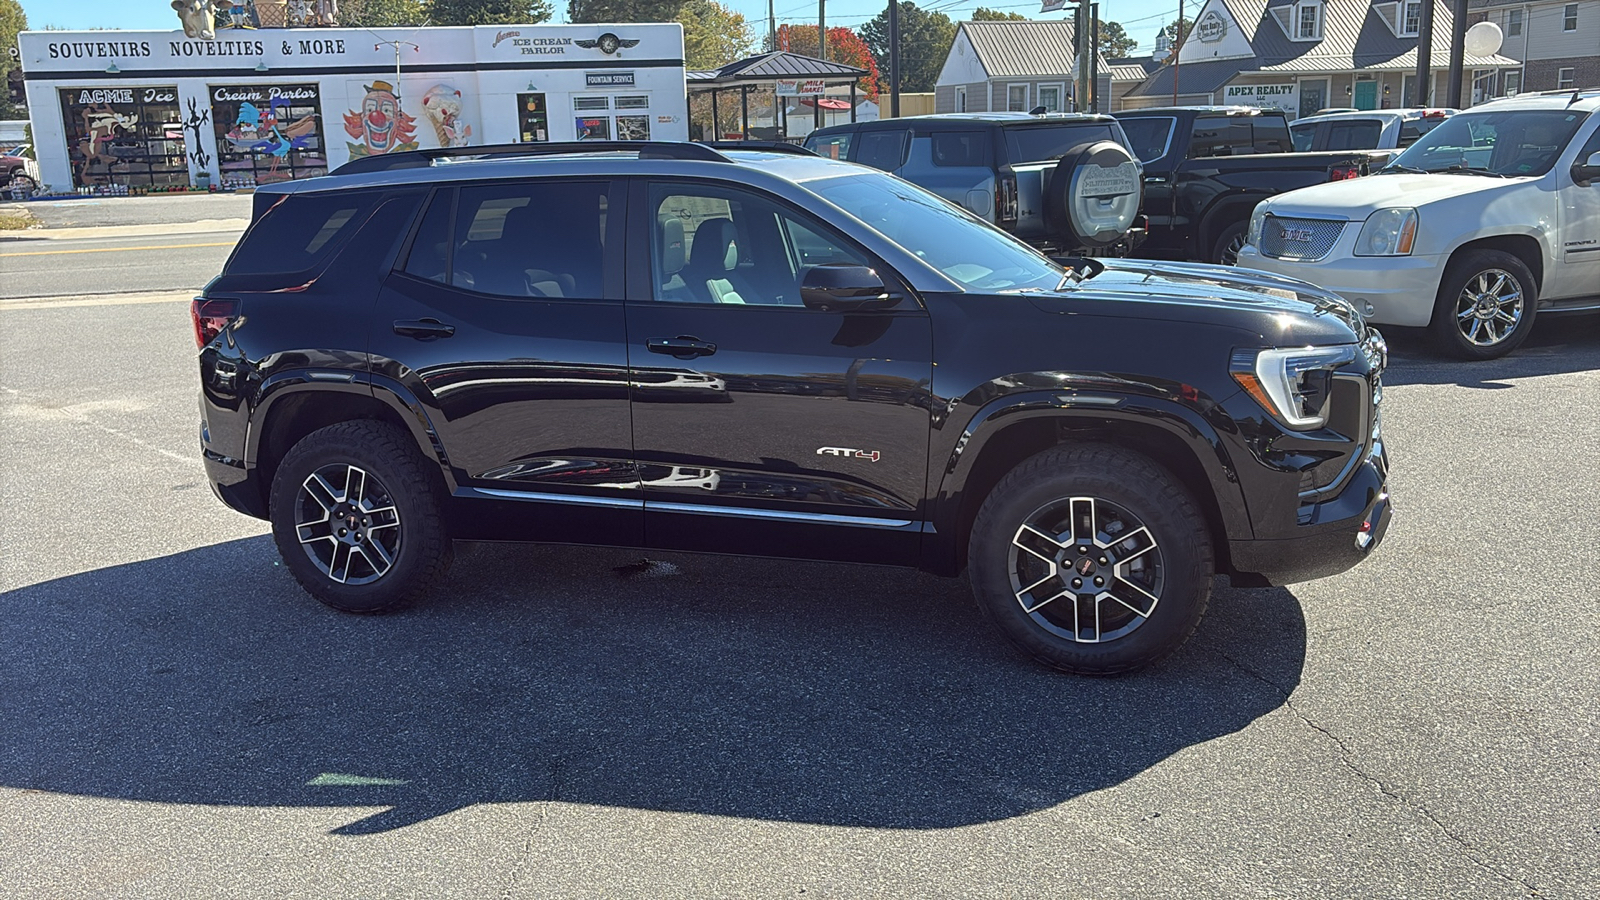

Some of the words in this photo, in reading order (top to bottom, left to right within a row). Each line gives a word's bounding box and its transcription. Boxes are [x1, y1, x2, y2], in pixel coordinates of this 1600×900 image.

[513, 38, 531, 46] ICE
[532, 37, 572, 46] CREAM
[48, 41, 151, 59] SOUVENIRS
[169, 40, 264, 57] NOVELTIES
[281, 40, 293, 56] &
[298, 39, 346, 55] MORE
[521, 46, 565, 55] PARLOR
[587, 76, 612, 84] FOUNTAIN
[612, 75, 634, 83] SERVICE
[79, 89, 134, 104] ACME
[143, 88, 175, 103] Ice
[214, 87, 262, 102] Cream
[268, 86, 317, 101] Parlor
[1228, 87, 1254, 96] APEX
[1256, 85, 1294, 95] REALTY
[1280, 229, 1312, 241] GMC
[816, 446, 880, 462] AT4
